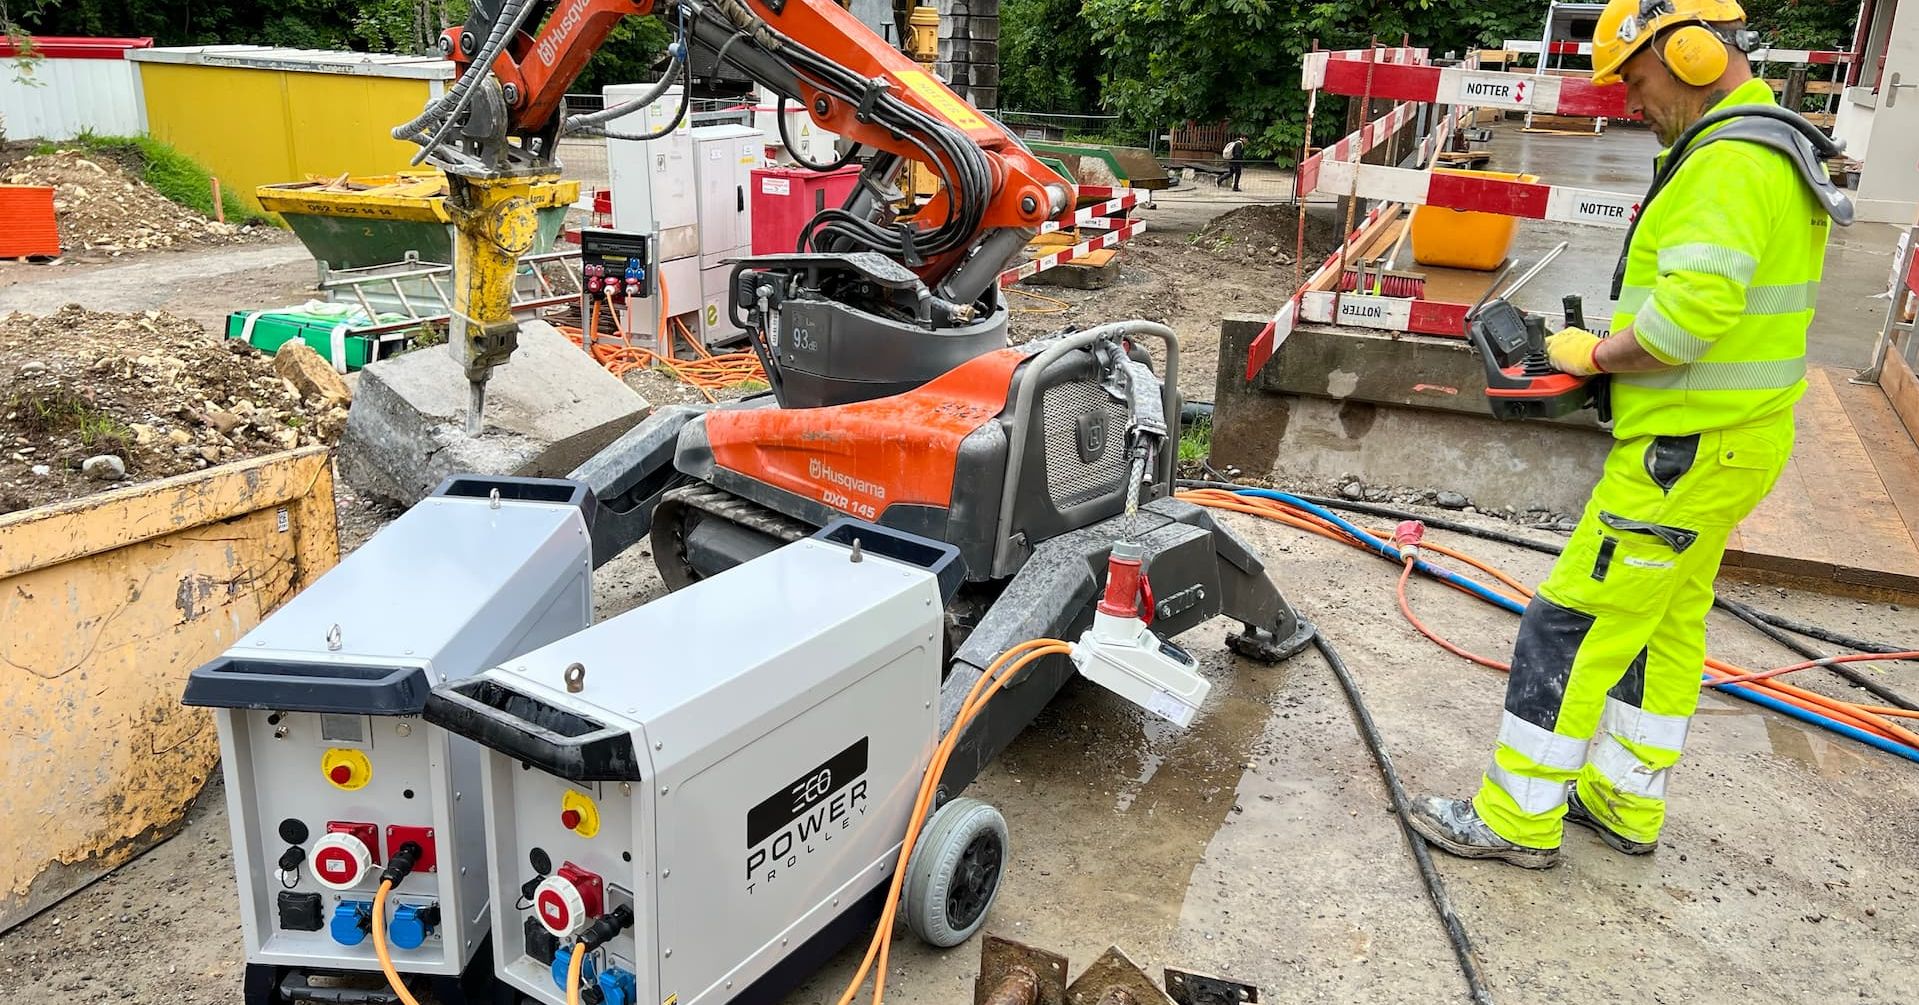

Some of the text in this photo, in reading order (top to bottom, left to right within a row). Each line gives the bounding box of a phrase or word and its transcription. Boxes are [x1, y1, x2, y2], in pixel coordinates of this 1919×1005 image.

[1466, 82, 1510, 98] NOTTER
[1580, 202, 1625, 218] NOTTER
[1342, 304, 1382, 319] NOTTER
[822, 463, 886, 500] Husqvarna
[823, 489, 876, 520] DXR 145
[791, 768, 832, 814] ECO
[747, 779, 868, 881] POWER
[746, 804, 868, 895] TROLLEY
